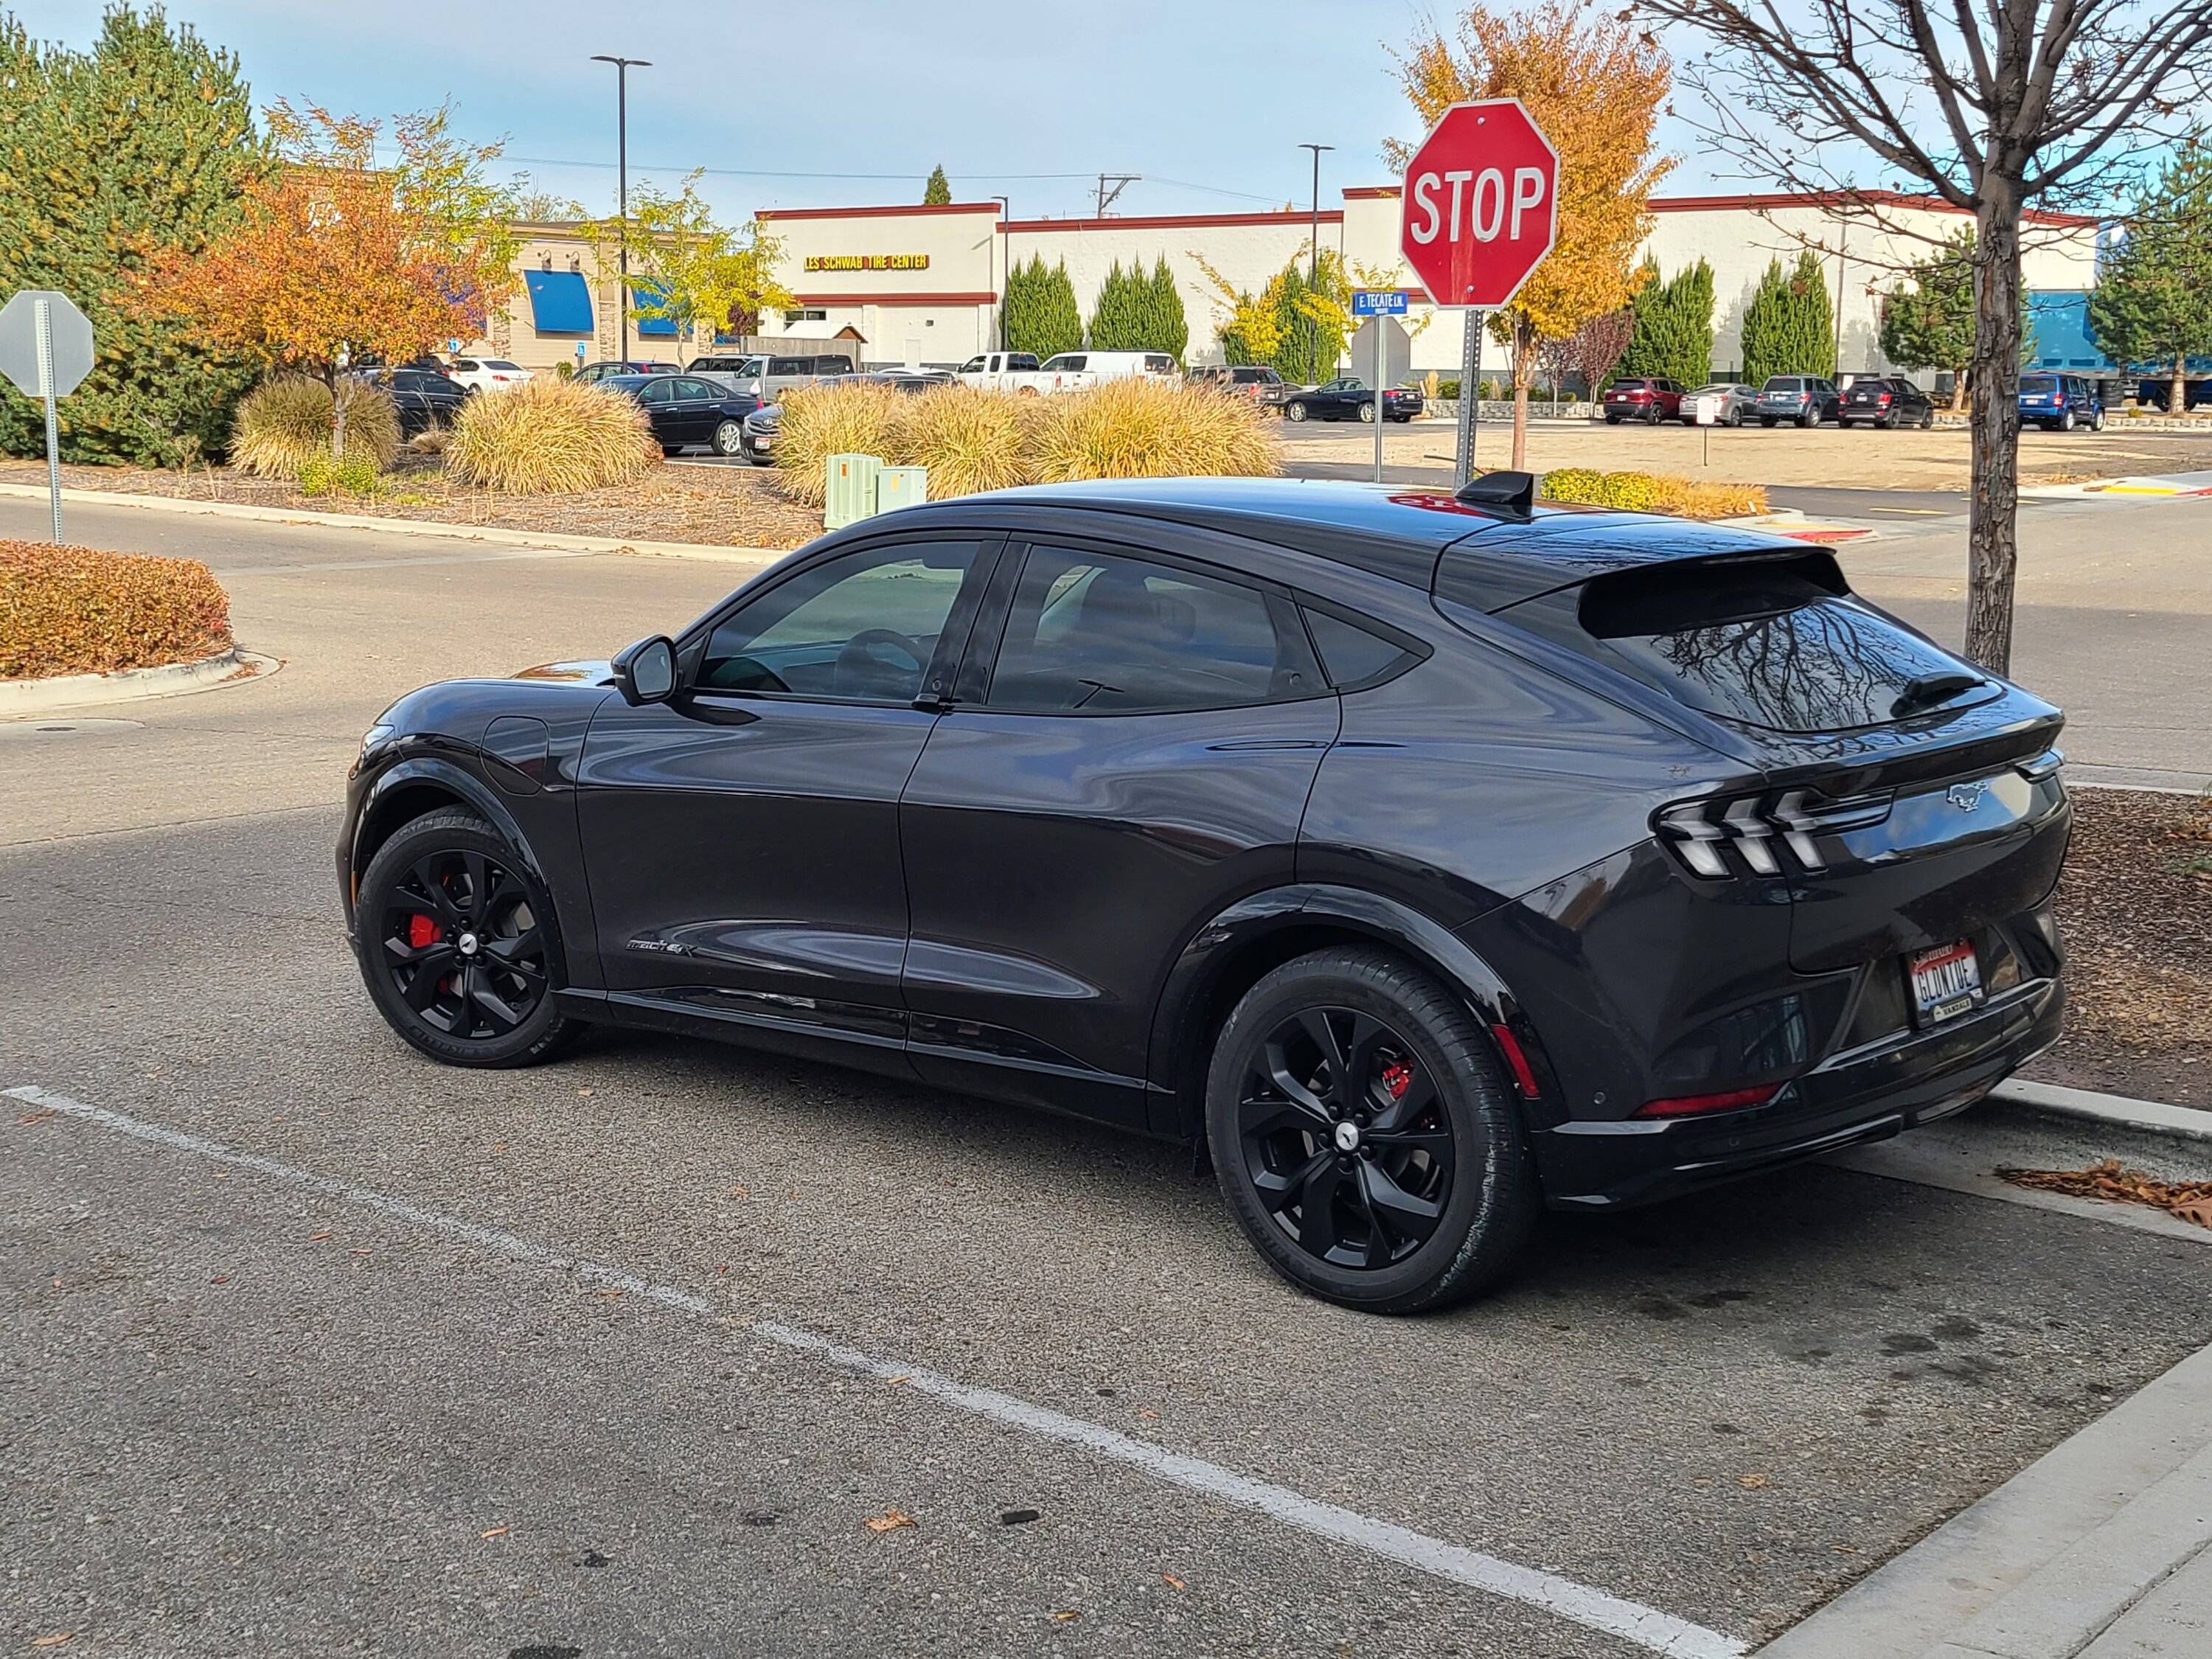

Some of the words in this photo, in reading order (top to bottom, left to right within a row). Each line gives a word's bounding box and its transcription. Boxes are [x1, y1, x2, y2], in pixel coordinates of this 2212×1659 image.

[1410, 167, 1545, 245] STOP
[805, 257, 821, 270] LES
[824, 256, 863, 270] SCHWAB
[867, 255, 888, 269] TIRE
[891, 254, 927, 268] CENTER
[1366, 293, 1394, 307] TECATE
[1918, 956, 1972, 1003] GLDNTOE
